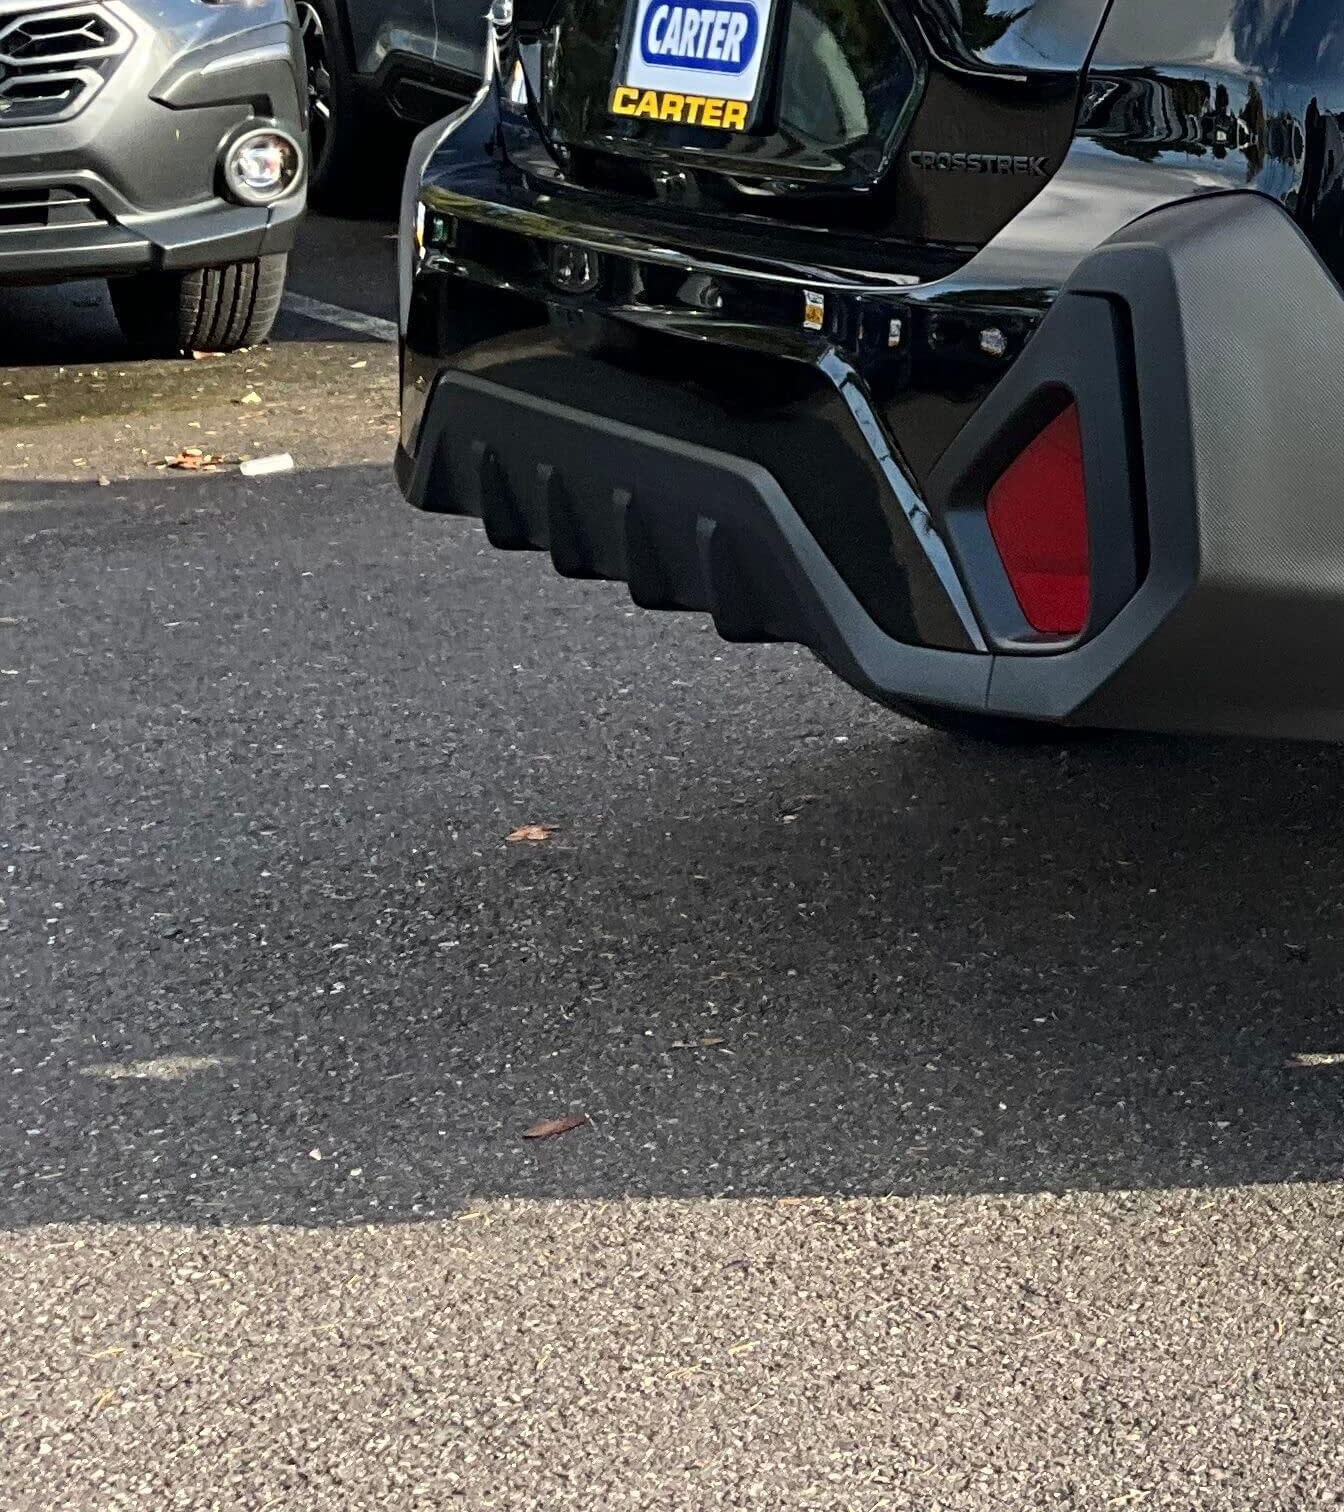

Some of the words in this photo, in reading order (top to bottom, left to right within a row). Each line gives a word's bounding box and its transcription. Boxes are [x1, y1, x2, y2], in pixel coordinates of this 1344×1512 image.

[648, 2, 750, 63] CARTER
[612, 86, 749, 131] CARTER
[908, 150, 1050, 177] CROSSTREK
